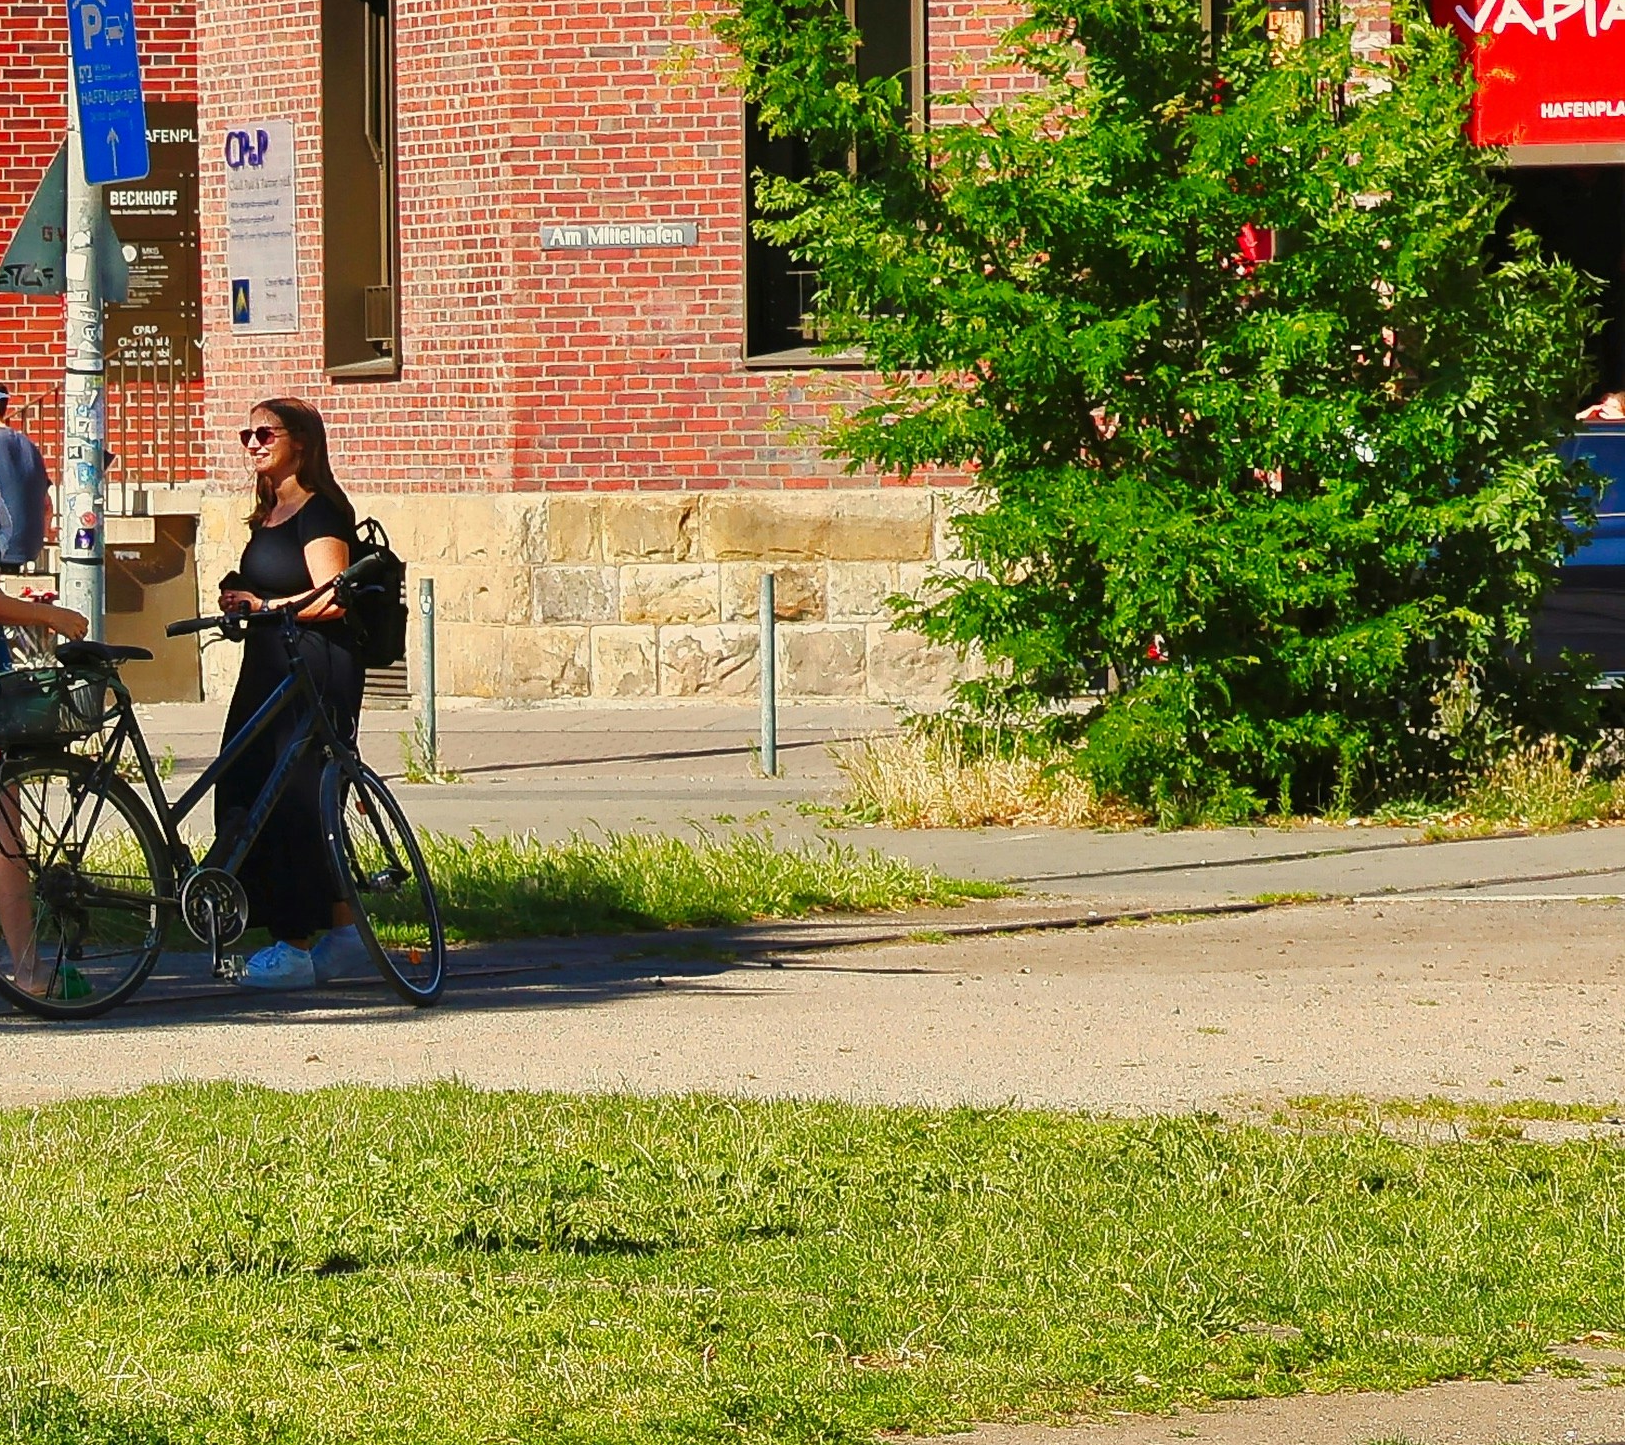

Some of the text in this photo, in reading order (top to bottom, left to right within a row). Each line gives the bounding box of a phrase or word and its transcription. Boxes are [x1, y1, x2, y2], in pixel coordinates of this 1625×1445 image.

[109, 190, 178, 206] BECKHOFF
[549, 225, 684, 246] Am Mittelhafen
